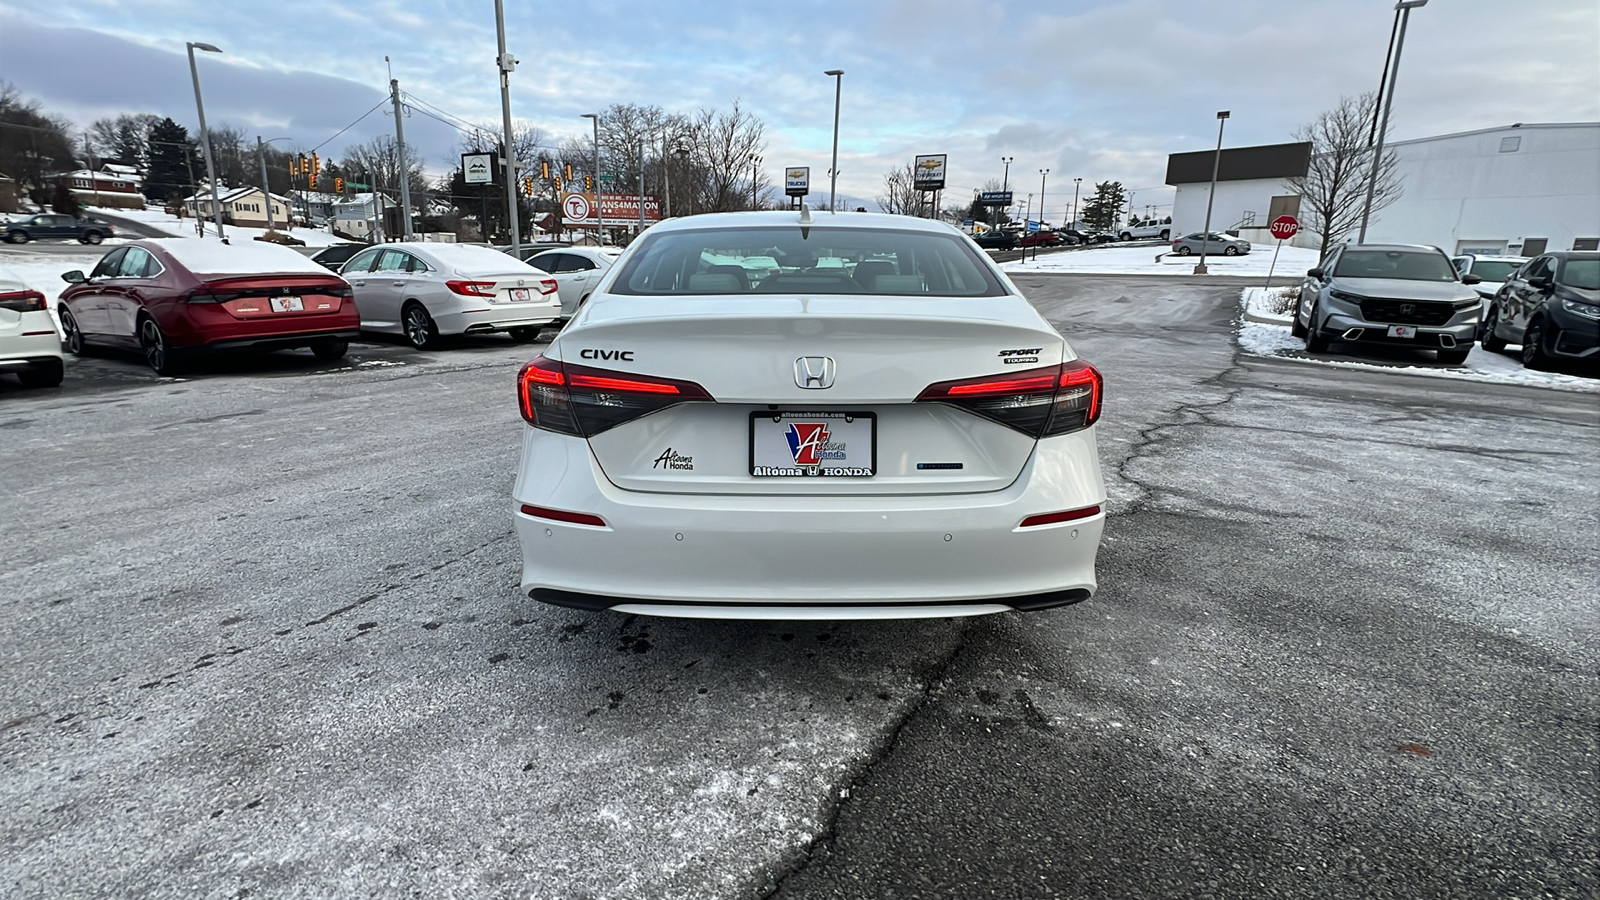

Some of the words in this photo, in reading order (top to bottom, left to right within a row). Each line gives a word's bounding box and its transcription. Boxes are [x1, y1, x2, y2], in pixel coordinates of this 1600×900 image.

[590, 200, 658, 210] TANS4MATON
[1272, 222, 1297, 233] STOP
[580, 349, 634, 361] CIVIC
[998, 348, 1043, 356] SPORT
[815, 450, 845, 459] Honda
[670, 461, 693, 470] Honda
[753, 466, 803, 476] Altoona
[824, 467, 873, 476] HONDA
